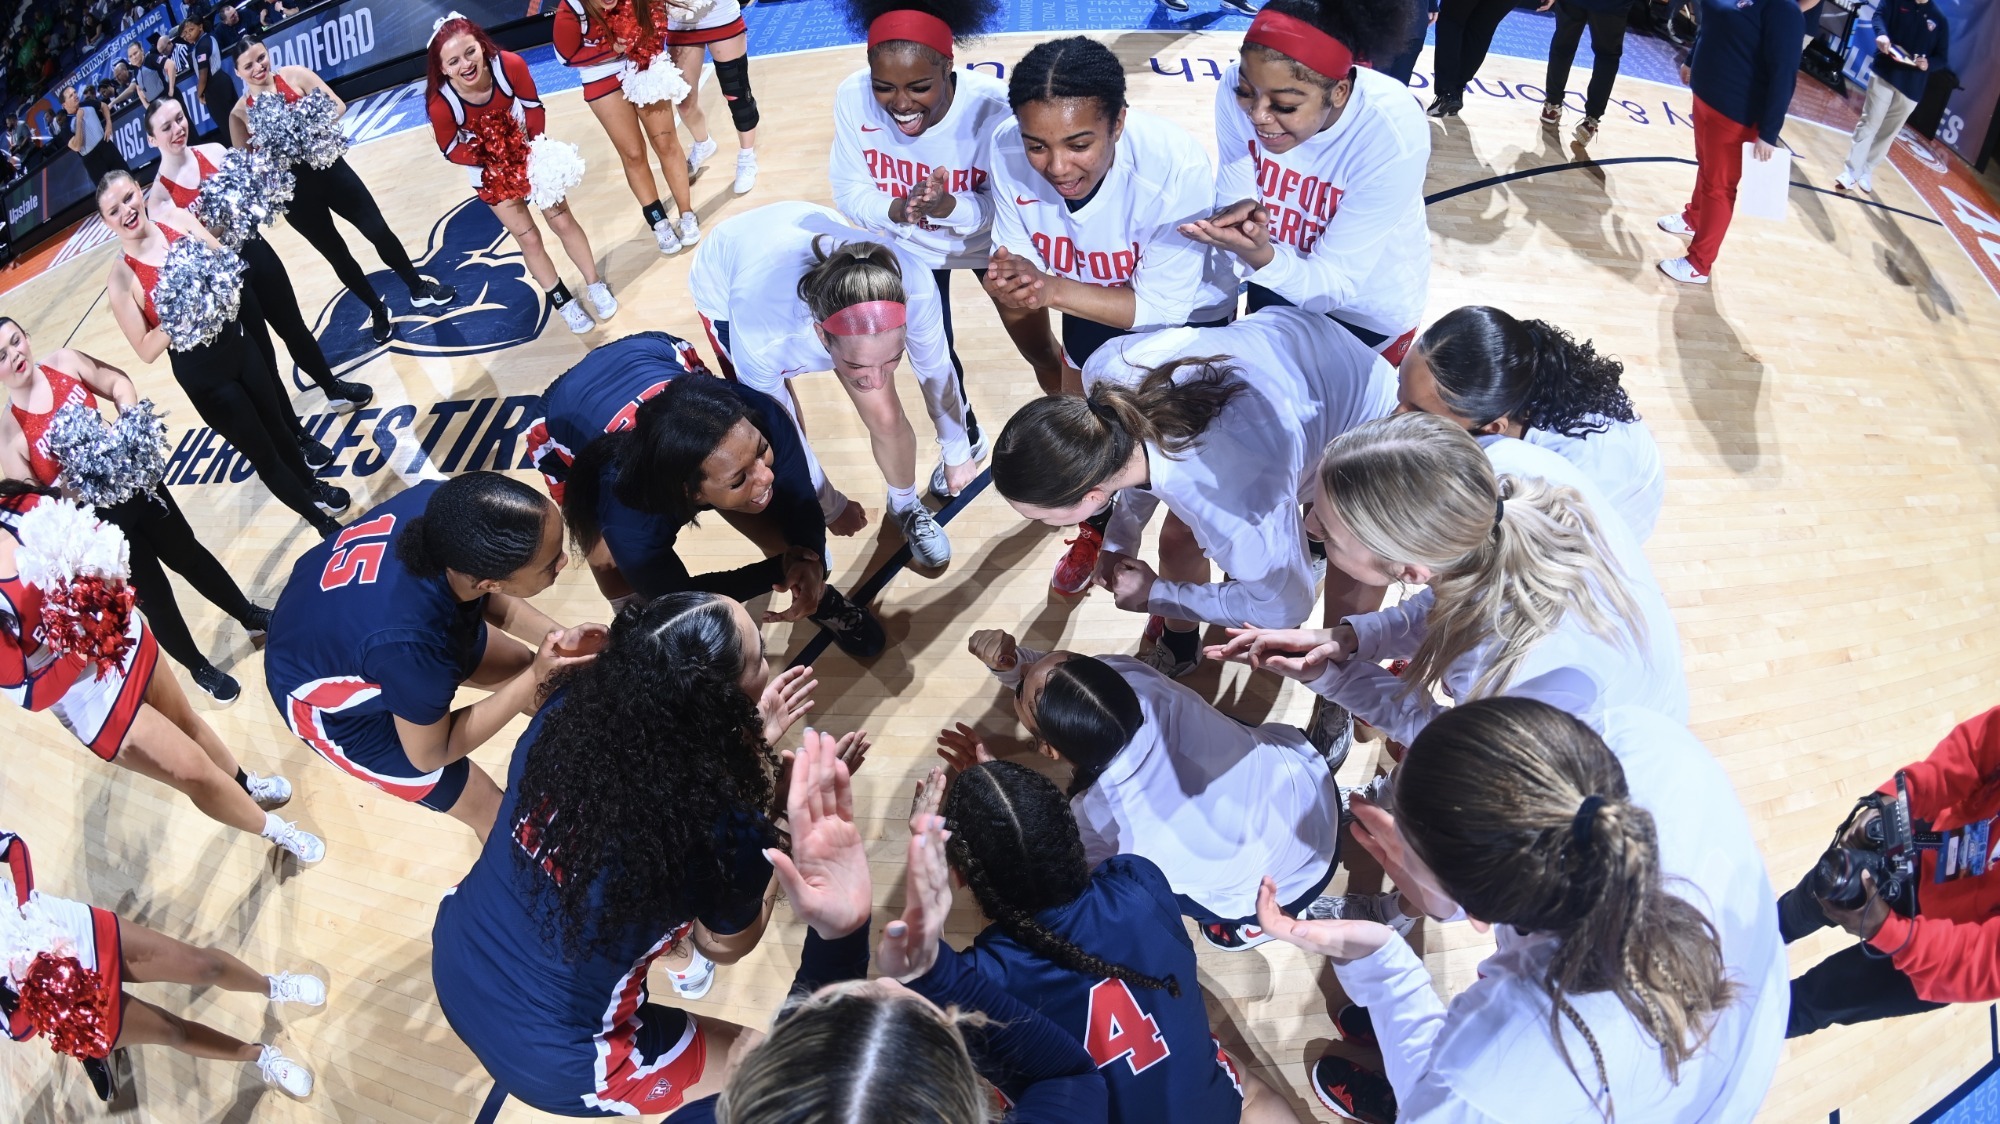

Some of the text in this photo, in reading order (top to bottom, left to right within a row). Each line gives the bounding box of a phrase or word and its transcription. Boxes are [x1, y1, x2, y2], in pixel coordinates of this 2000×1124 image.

[54, 72, 83, 98] WHERE
[81, 41, 121, 78] WINNERS
[121, 29, 138, 47] ARE
[137, 10, 163, 33] MADE
[268, 7, 375, 73] RADFORD
[114, 118, 142, 161] USC
[863, 148, 988, 193] RADFRD
[9, 194, 38, 225] Upstate
[1032, 231, 1140, 281] ADFOR
[404, 394, 541, 475] TIR
[319, 513, 397, 593] 15
[1083, 976, 1171, 1076] 4
